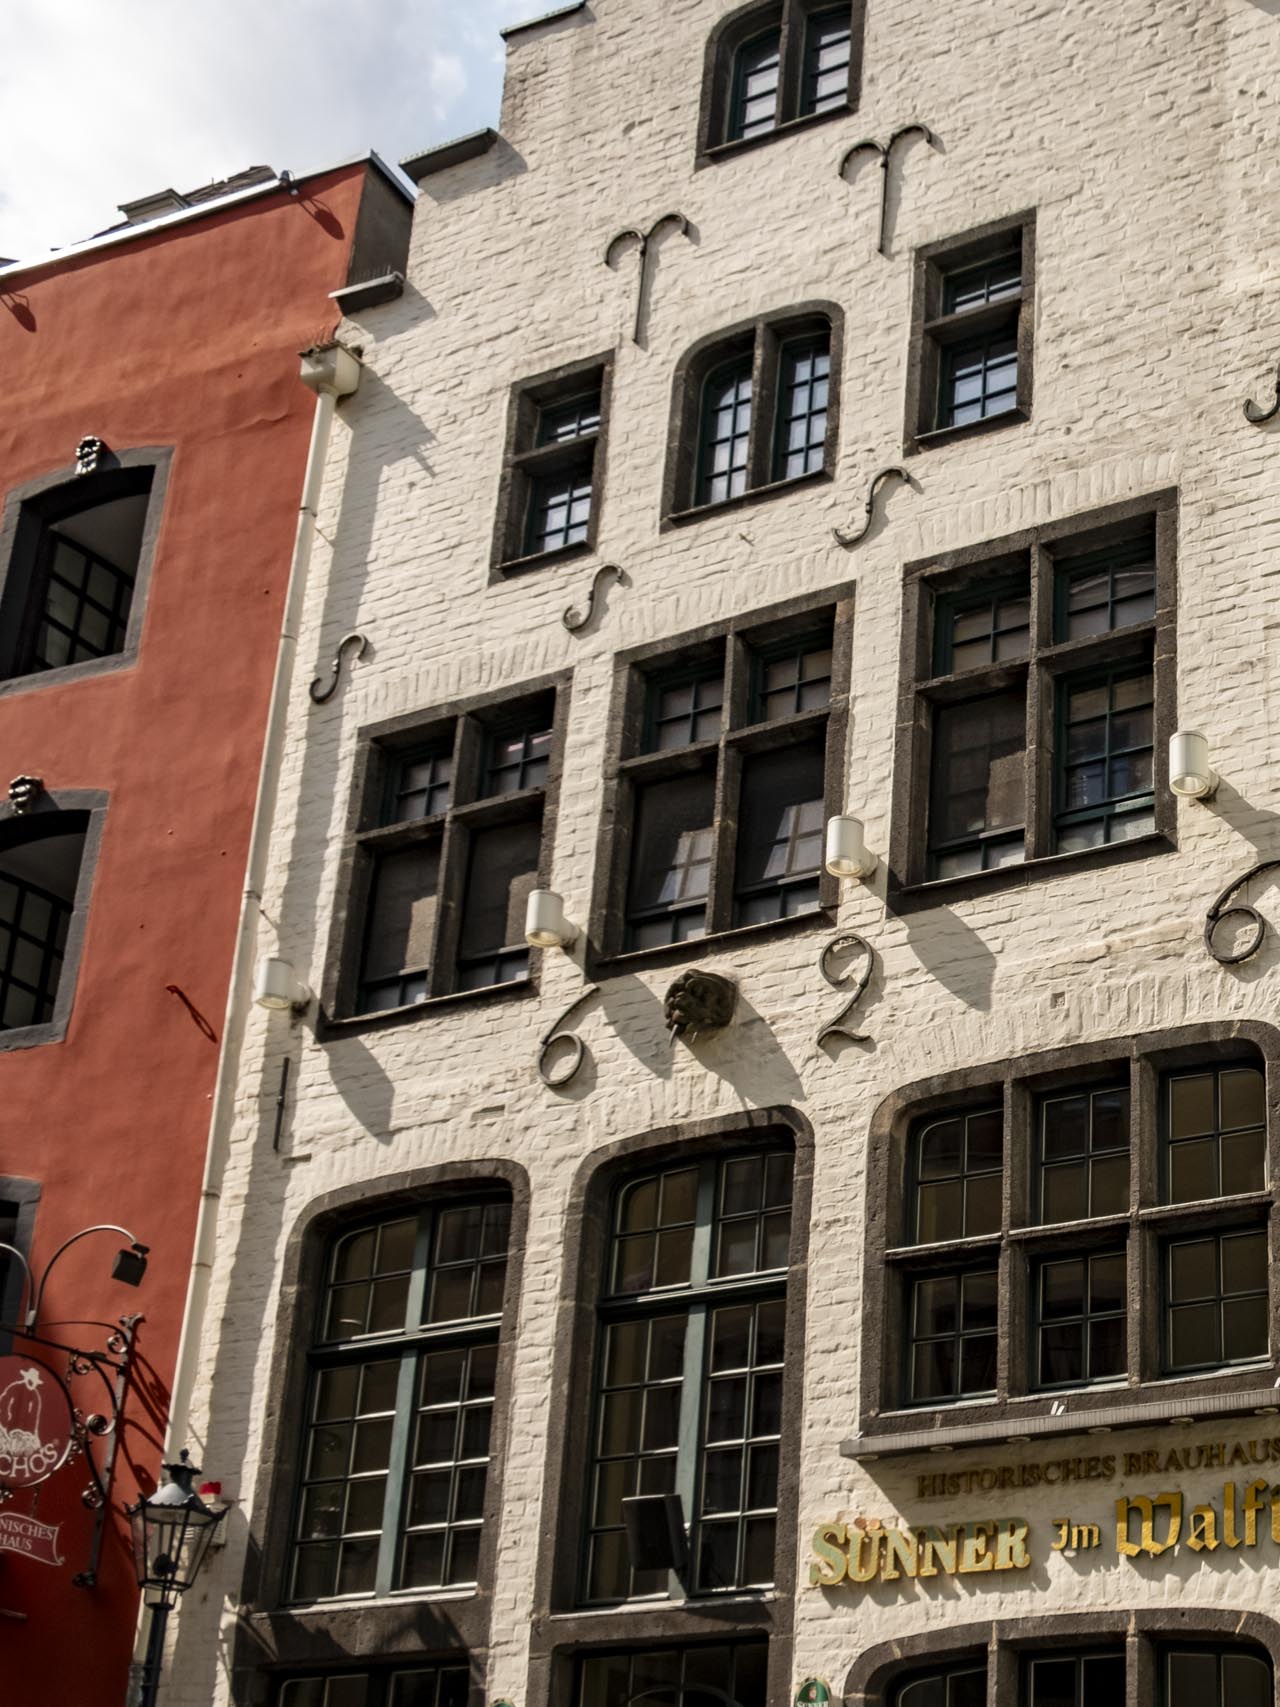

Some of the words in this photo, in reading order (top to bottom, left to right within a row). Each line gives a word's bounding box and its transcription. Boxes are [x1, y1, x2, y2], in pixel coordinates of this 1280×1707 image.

[817, 932, 875, 1049] 2
[917, 1453, 1117, 1499] HISTORISCHES
[808, 1515, 1032, 1586] SÜNNER
